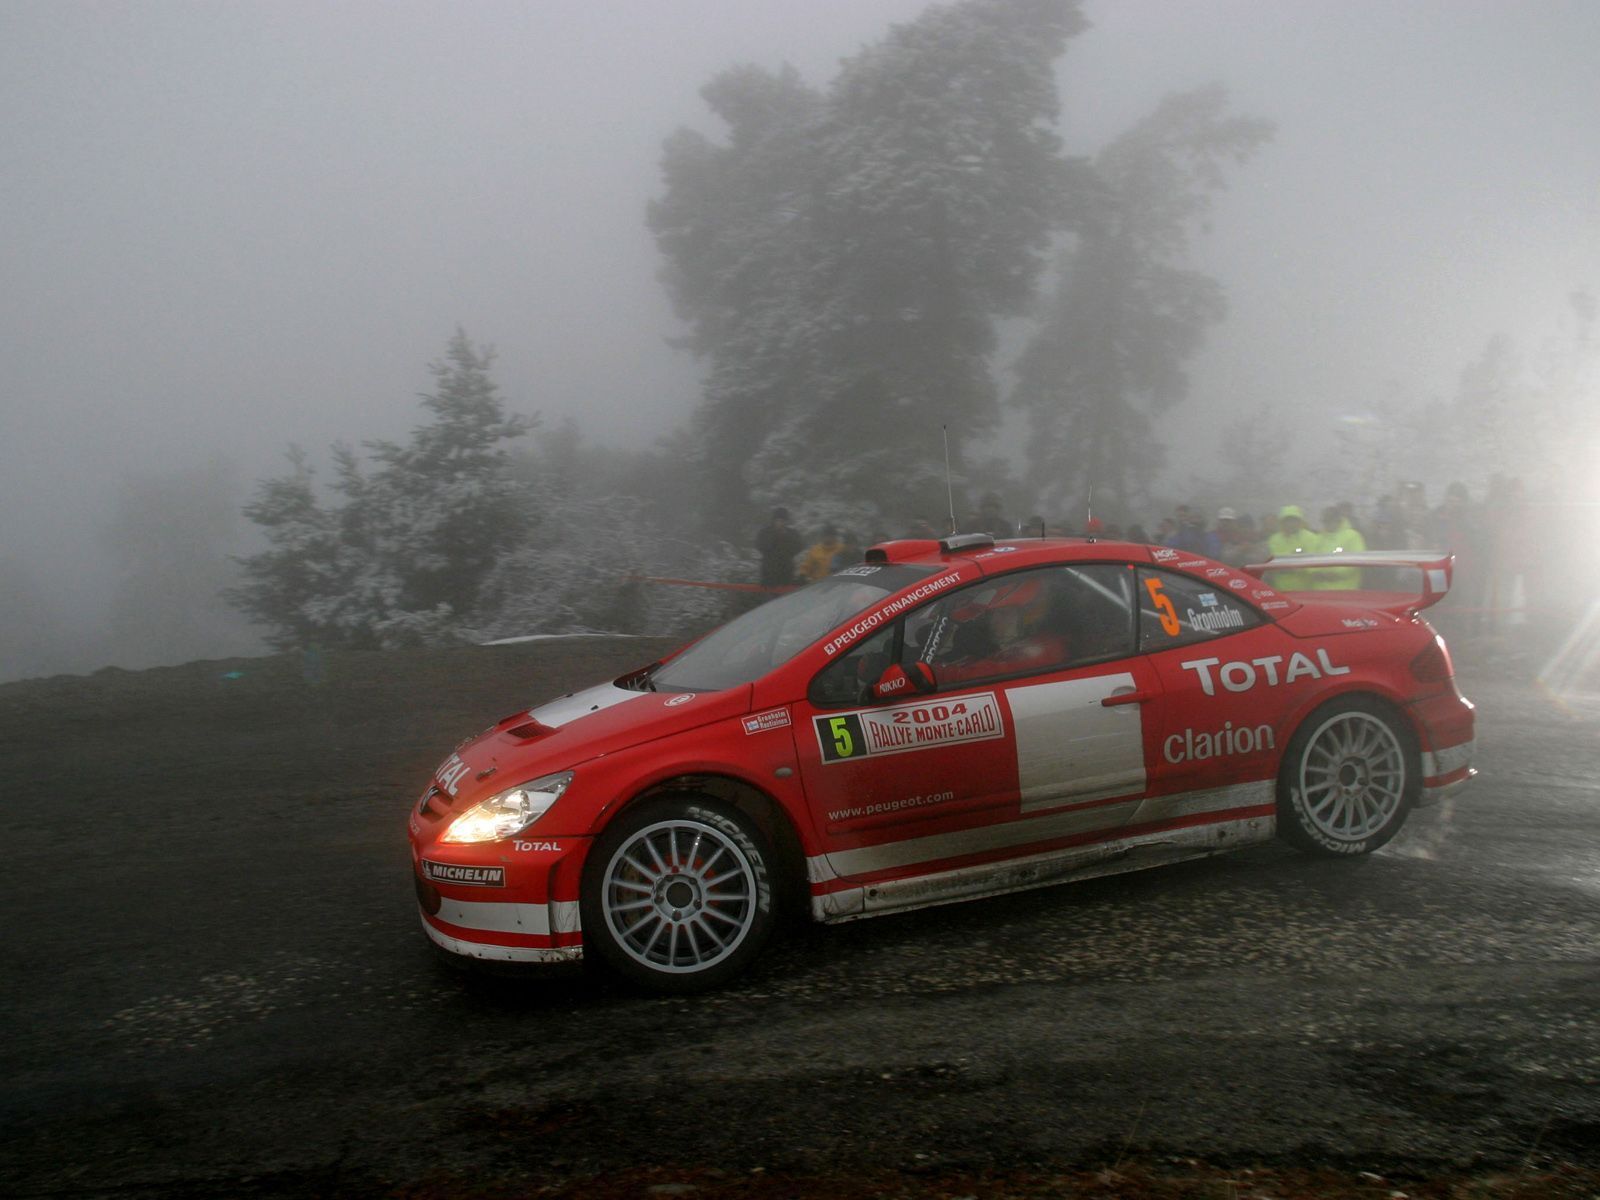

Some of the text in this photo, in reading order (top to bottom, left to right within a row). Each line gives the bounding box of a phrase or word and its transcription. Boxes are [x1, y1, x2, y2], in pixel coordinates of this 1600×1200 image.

[834, 572, 962, 648] PEUGEOT FINANCEMENT
[1144, 578, 1181, 637] 5
[880, 677, 905, 693] NIKKO
[1181, 648, 1350, 696] TOTAL
[892, 703, 968, 724] 2004
[829, 717, 853, 758] 5
[869, 720, 913, 749] RALLYE
[1163, 720, 1275, 764] clarion
[828, 789, 954, 820] www.peugeot.com
[513, 840, 562, 852] TOTAL
[687, 806, 771, 913] MICHELIN
[432, 865, 502, 881] MICHELIN
